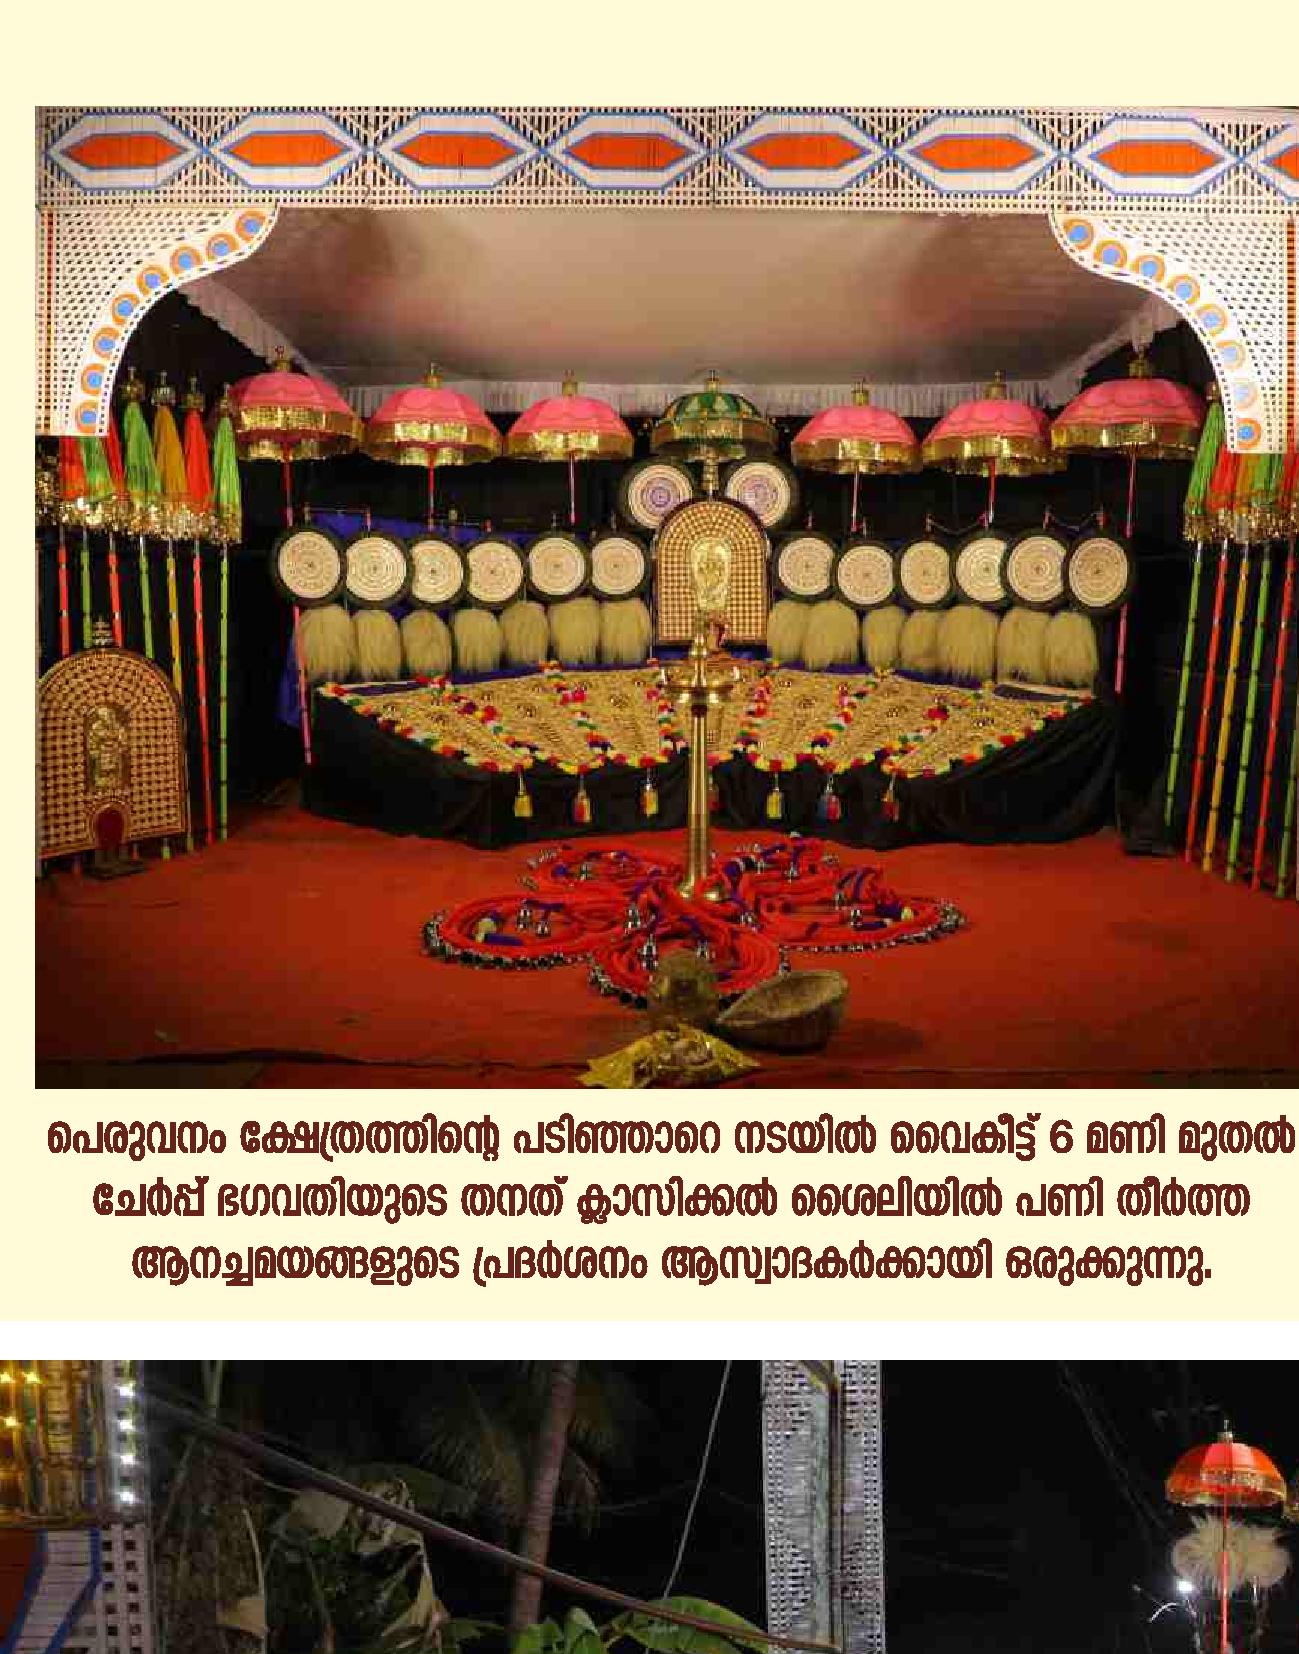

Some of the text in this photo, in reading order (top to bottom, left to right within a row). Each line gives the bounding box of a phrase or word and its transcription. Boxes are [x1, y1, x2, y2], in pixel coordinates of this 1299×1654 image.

[48, 1121, 226, 1161] പെരുവനം
[514, 1113, 720, 1153] പടിഞ്ഞാറെ
[735, 1113, 876, 1153] നടയിൽ
[891, 1113, 1041, 1161] വൈകീട്ട്
[1050, 1119, 1073, 1153] 6
[1087, 1113, 1165, 1153] മണി
[1179, 1115, 1295, 1161] മുതൽ
[93, 1176, 1250, 1224] ചേർപ്പ് ഭഗവതിയുടെ തനത് ക്ലാസിക്കൽ ശൈലിയിൽ പണി തീർത്ത
[132, 1238, 1211, 1287] ആനച്ചമയങ്ങളുടെ പ്രദർശനം ആസ്വാദകർക്കായി ഒരുക്കുന്നു.
